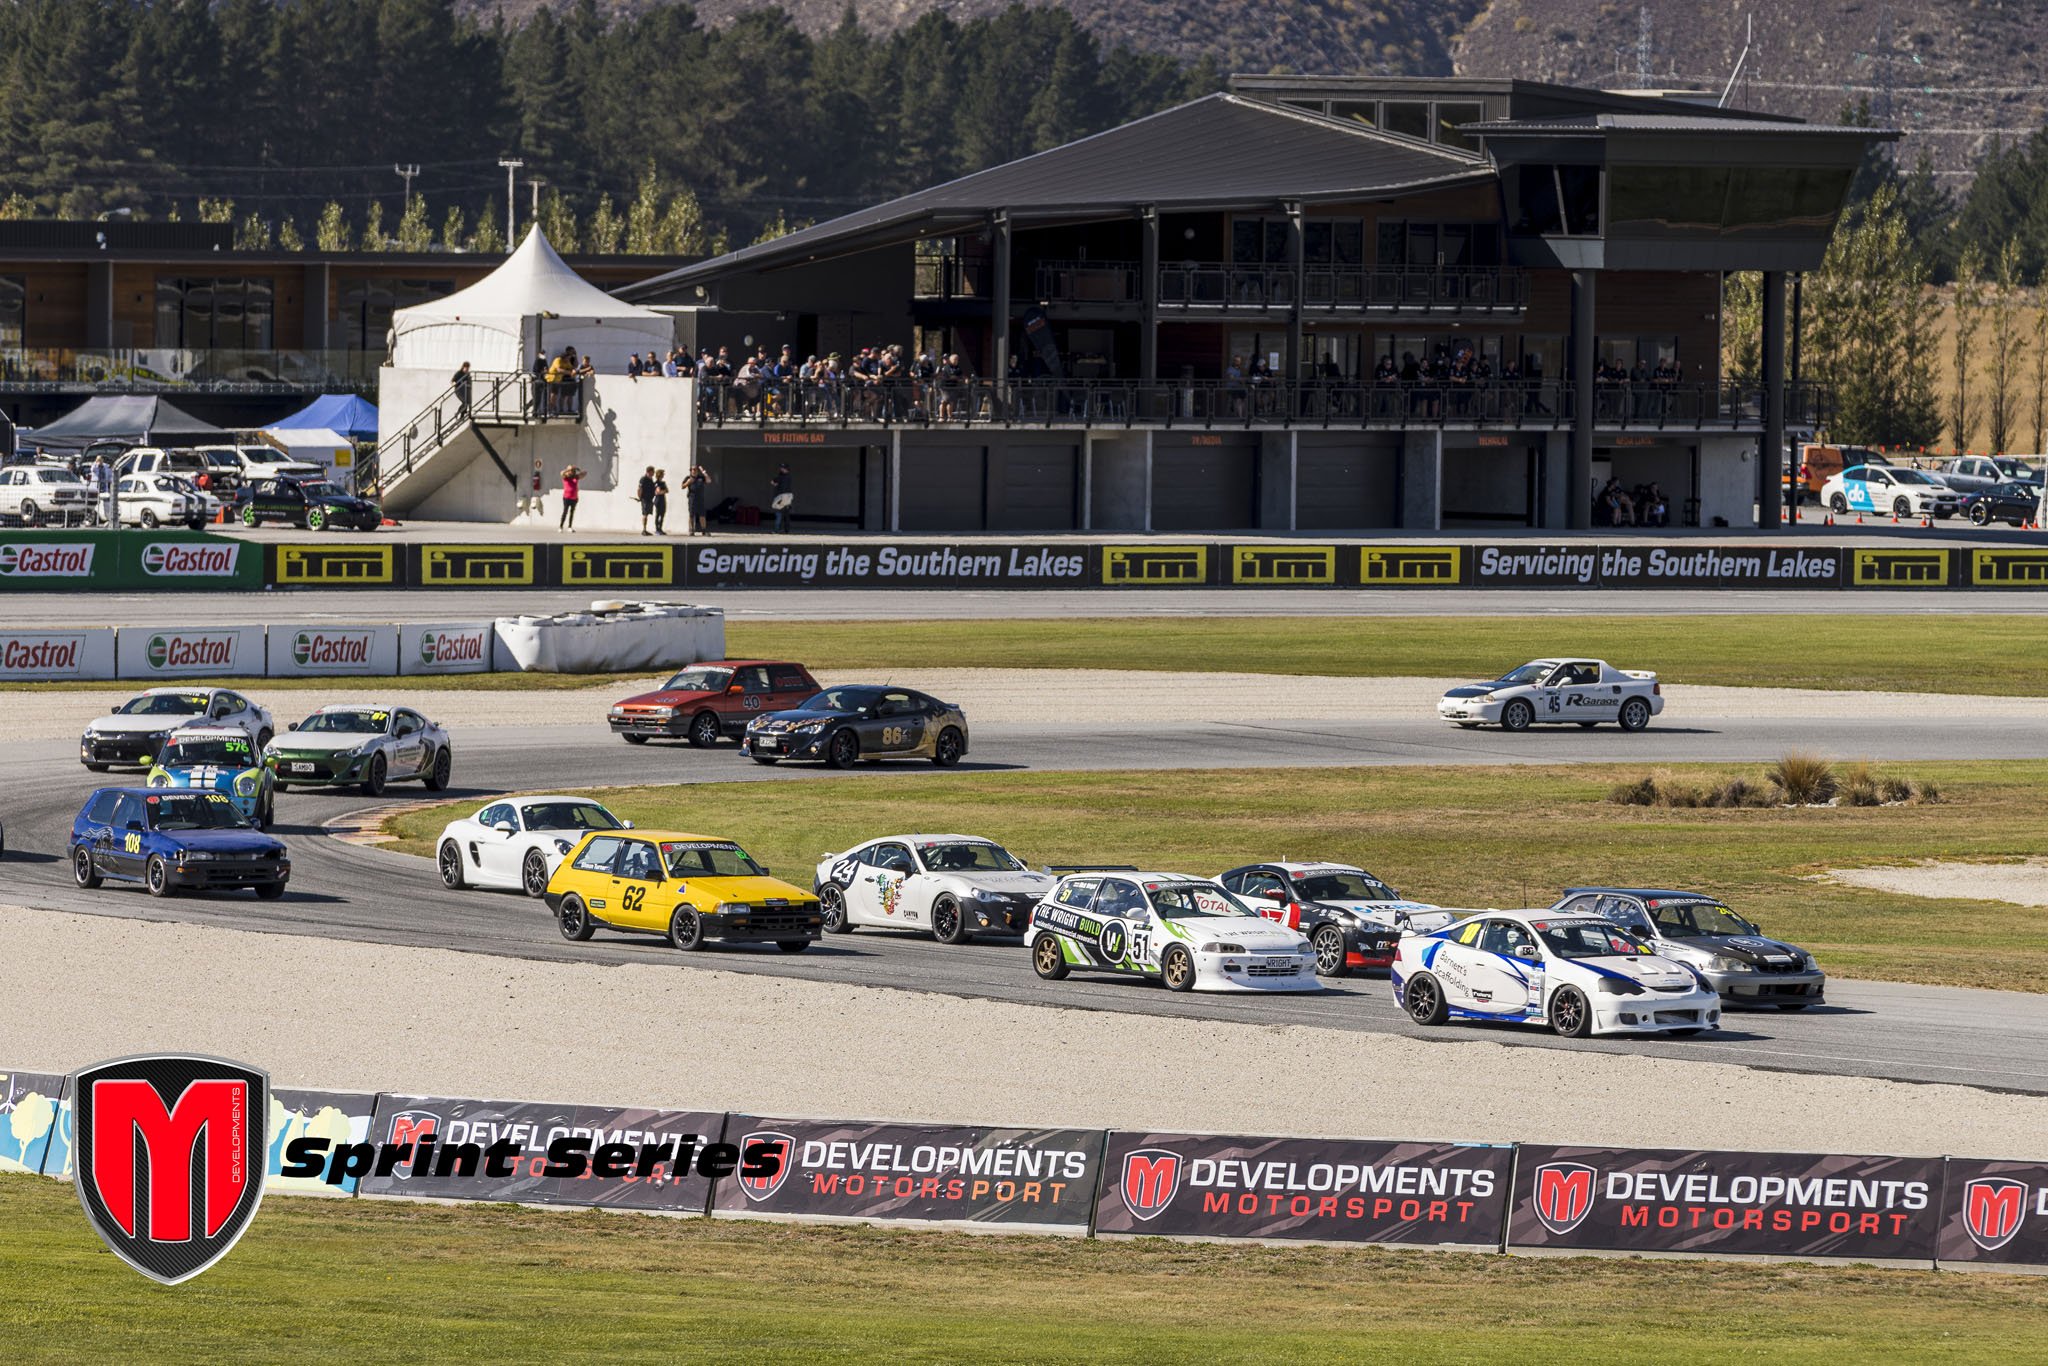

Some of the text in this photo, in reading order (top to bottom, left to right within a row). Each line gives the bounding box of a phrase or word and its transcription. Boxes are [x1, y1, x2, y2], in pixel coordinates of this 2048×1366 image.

[19, 547, 87, 572] Castrol
[164, 547, 232, 571] Castrol
[697, 547, 1084, 579] Servicing the Southern Lakes
[1480, 547, 1836, 583] Servicing the Southern Lakes
[4, 640, 78, 669] Castrol
[168, 637, 232, 665] Castrol
[311, 634, 367, 663] Castrol
[436, 633, 483, 662] Castrol
[744, 695, 761, 710] 40
[1549, 695, 1561, 714] 45
[179, 735, 247, 745] DEVELOPMENTS
[226, 742, 250, 753] 576
[882, 727, 902, 745] 86
[205, 794, 229, 803] 108
[124, 832, 141, 854] 108
[831, 859, 859, 882] 24
[622, 885, 646, 912] 62
[1196, 895, 1231, 913] TOTAL
[1037, 904, 1101, 937] THE WRIGHT BUILD
[1133, 934, 1149, 961] 51
[1267, 958, 1291, 968] WRIGHT
[1439, 950, 1468, 977] Barnett's
[1433, 964, 1470, 998] Scaffolding
[801, 1140, 1087, 1179] DEVELOPMENTS
[812, 1173, 1067, 1204] MOTORSPORT
[1190, 1158, 1495, 1198] DEVELOPMENTS
[1605, 1172, 1929, 1211] DEVELOPMENTS
[1203, 1192, 1475, 1224] MOTORSPORT
[1621, 1206, 1908, 1236] MOTORSPORT
